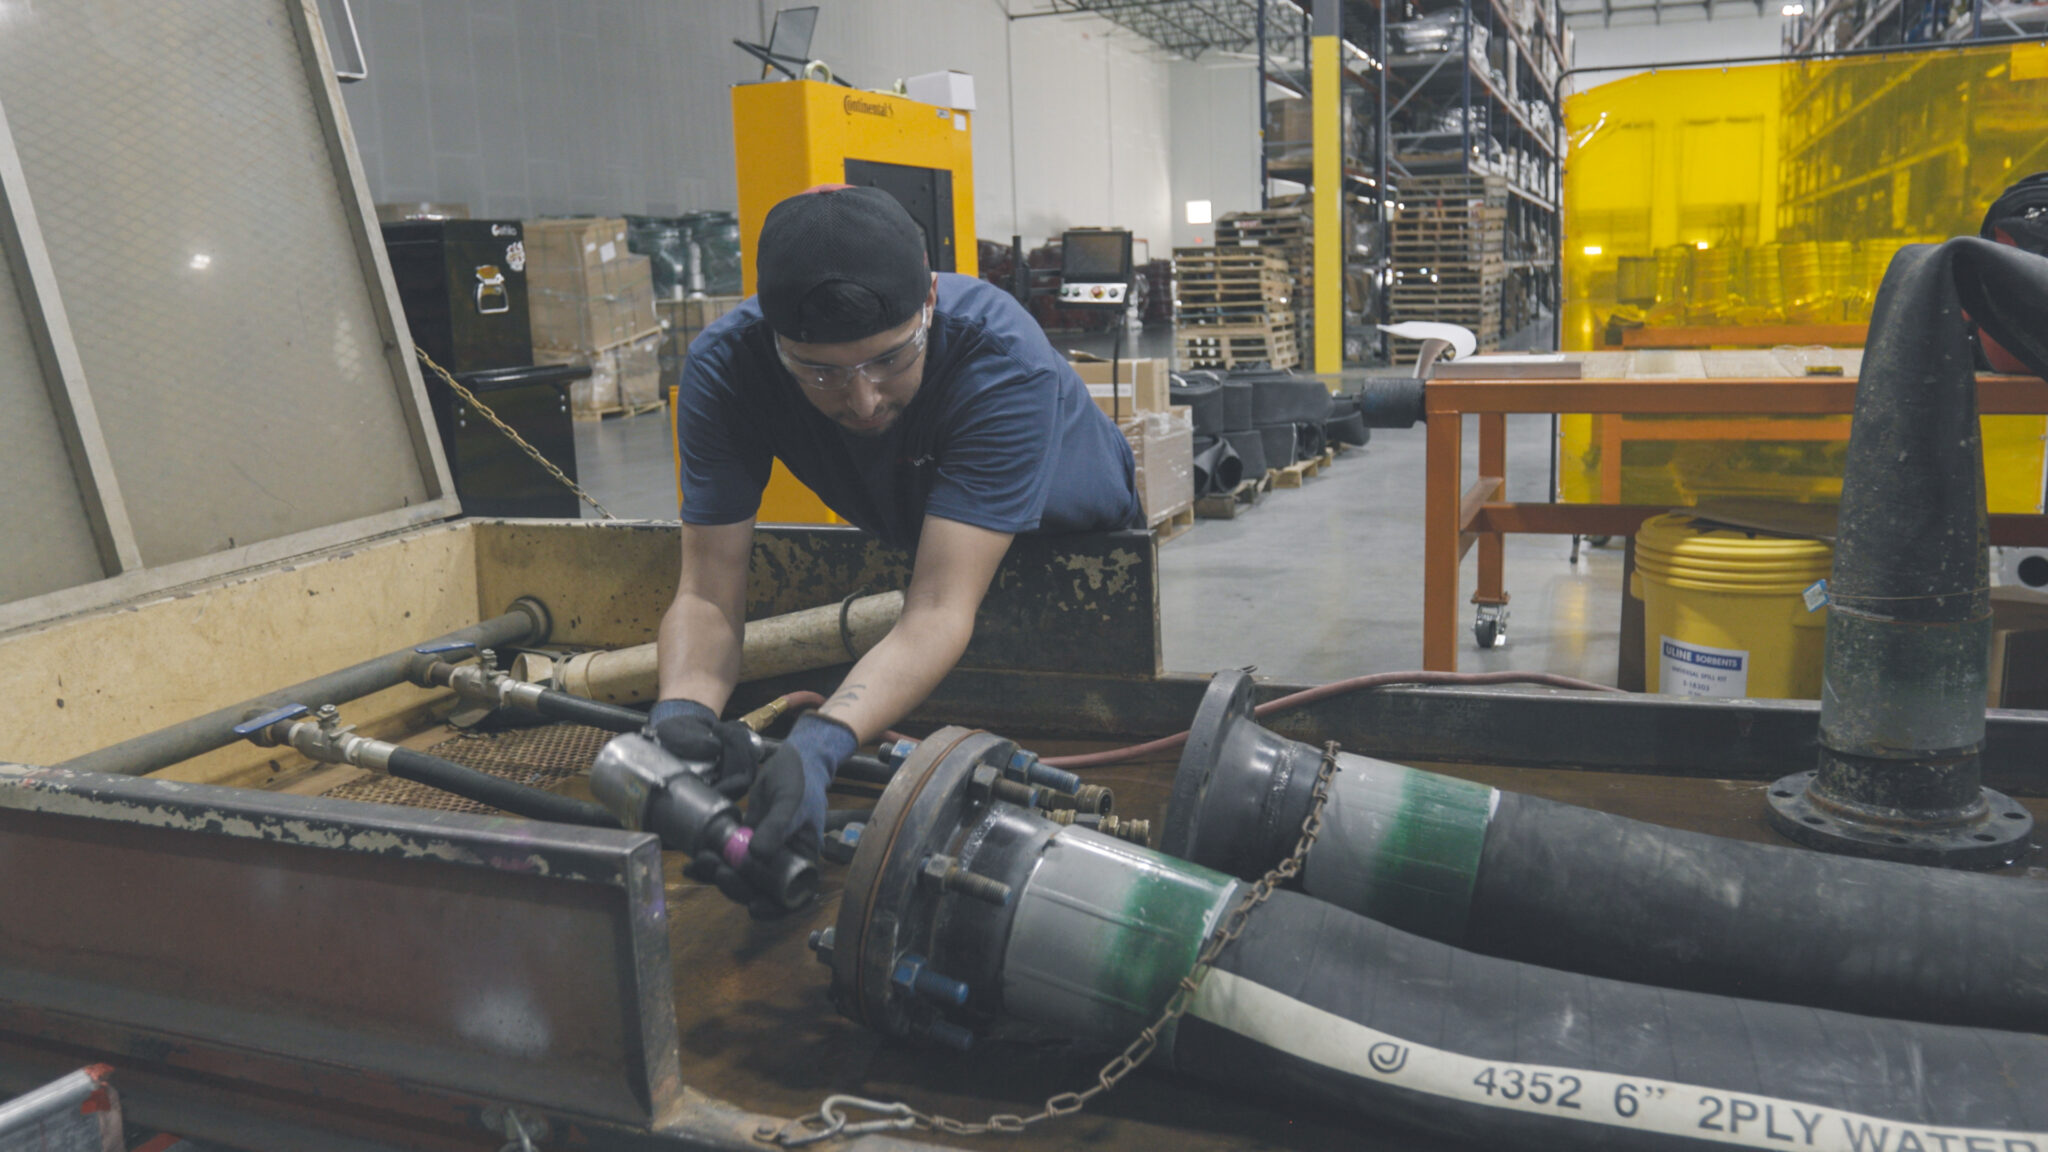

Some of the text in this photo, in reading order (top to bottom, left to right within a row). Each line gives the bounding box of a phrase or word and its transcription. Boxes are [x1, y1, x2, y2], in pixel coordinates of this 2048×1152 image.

[1666, 645, 1737, 668] ULINE SORBENTS
[1473, 1066, 1582, 1110] 4352
[1697, 1095, 1824, 1146] 2PLY
